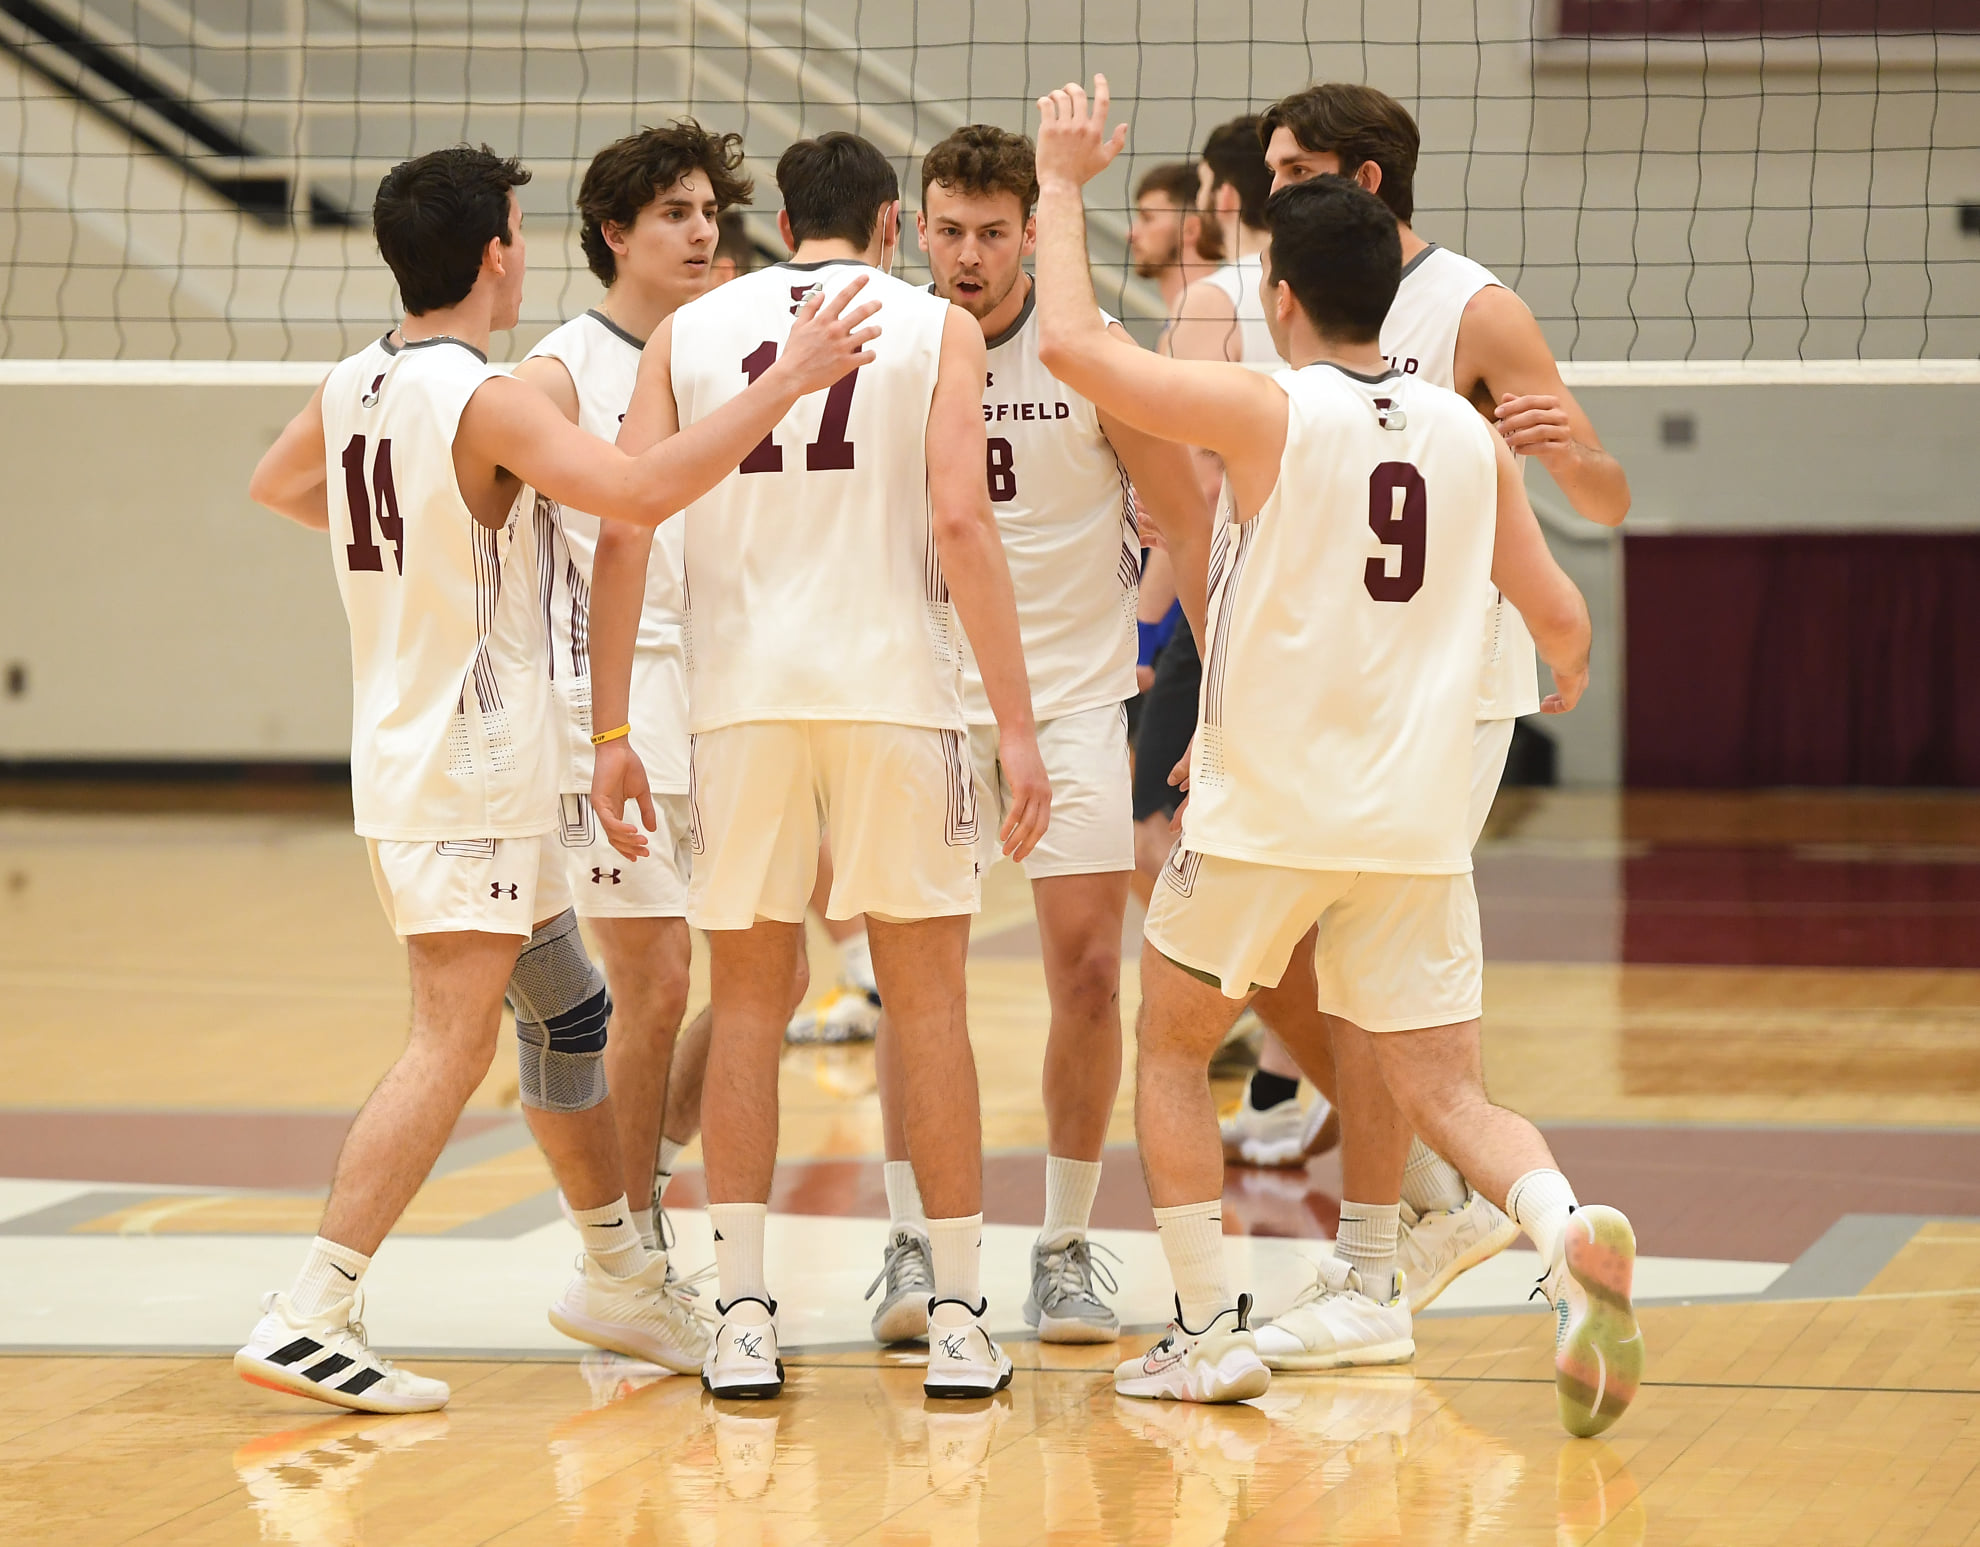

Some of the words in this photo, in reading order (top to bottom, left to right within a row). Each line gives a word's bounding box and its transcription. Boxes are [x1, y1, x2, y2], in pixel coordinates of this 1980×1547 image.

[739, 340, 863, 475] 17
[342, 434, 404, 576] 14
[1363, 461, 1427, 603] 9
